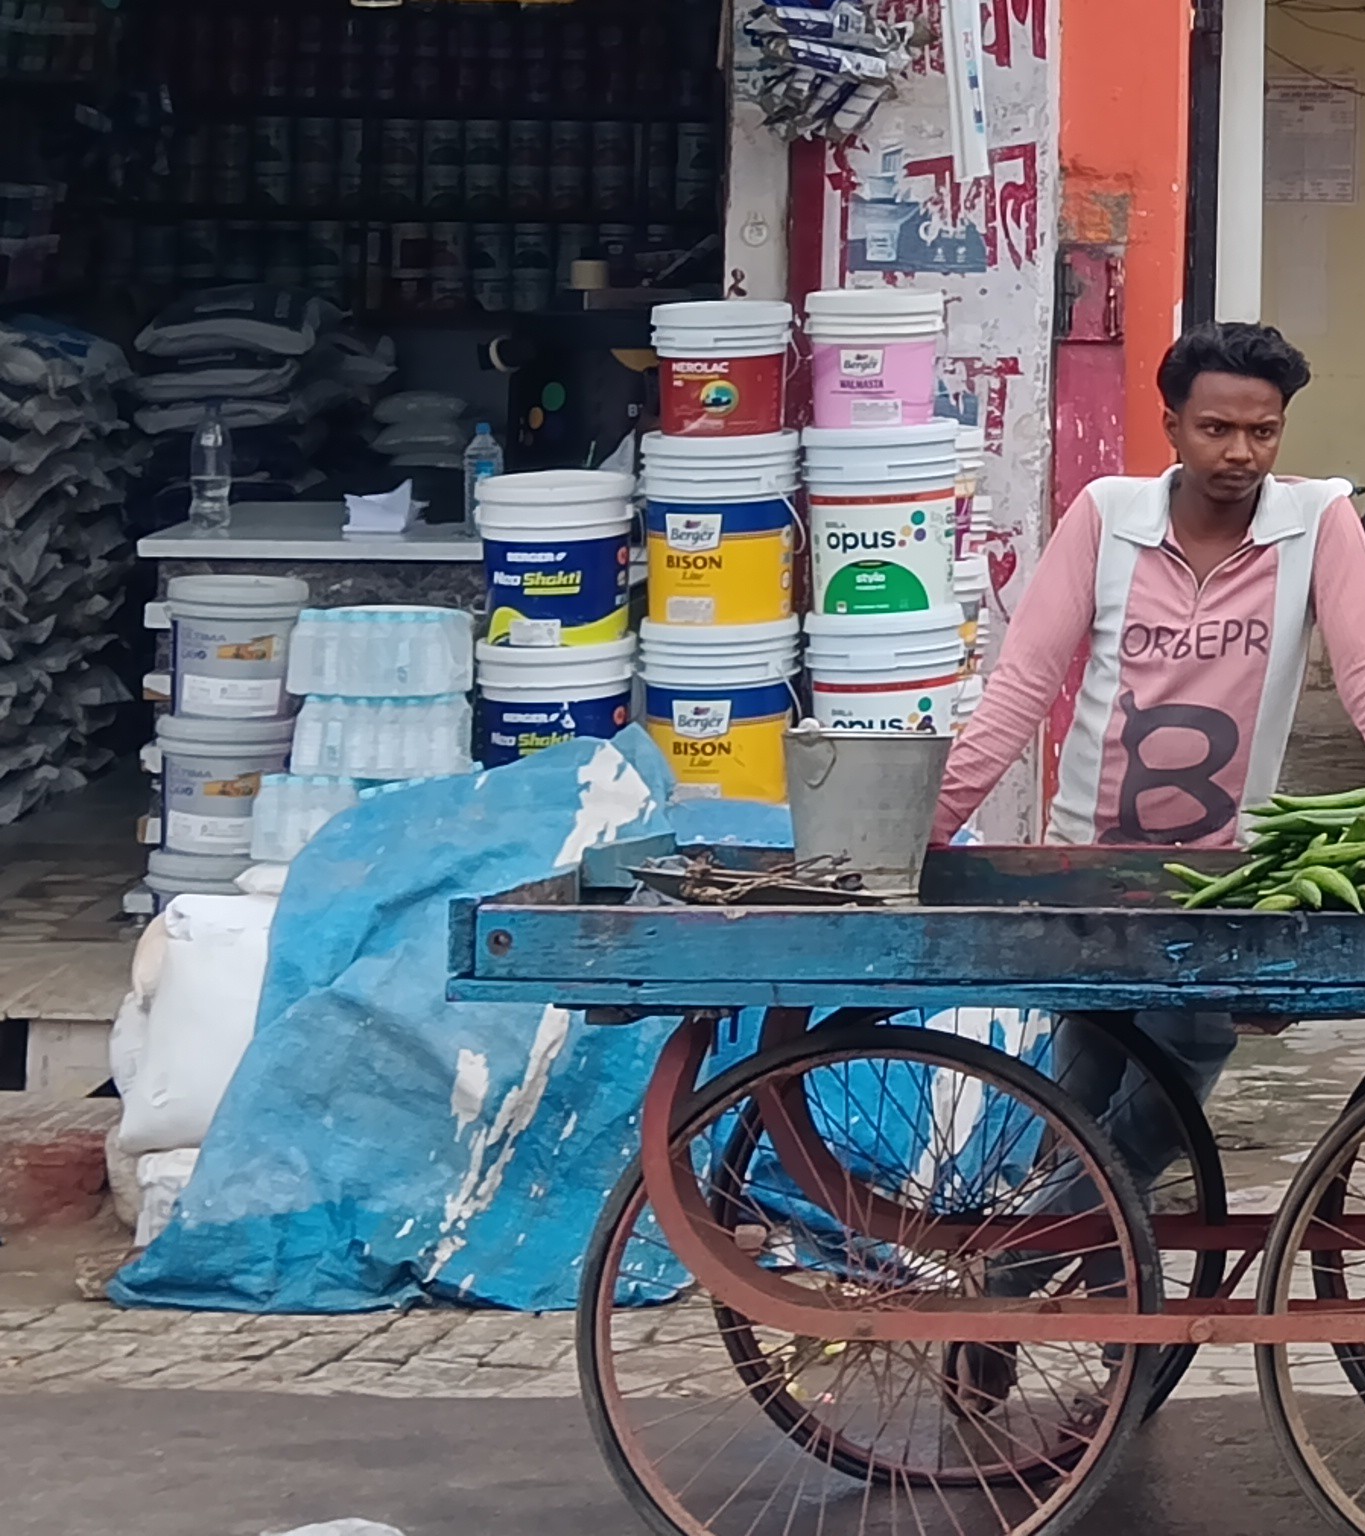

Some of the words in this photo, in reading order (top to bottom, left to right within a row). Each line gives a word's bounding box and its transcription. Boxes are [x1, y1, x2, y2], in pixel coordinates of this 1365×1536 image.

[670, 525, 715, 543] Berger
[827, 530, 896, 554] opus
[666, 555, 723, 569] BISON
[493, 571, 521, 586] Neo
[523, 570, 582, 586] Shakti
[677, 713, 724, 729] Berger
[672, 741, 732, 756] BISON
